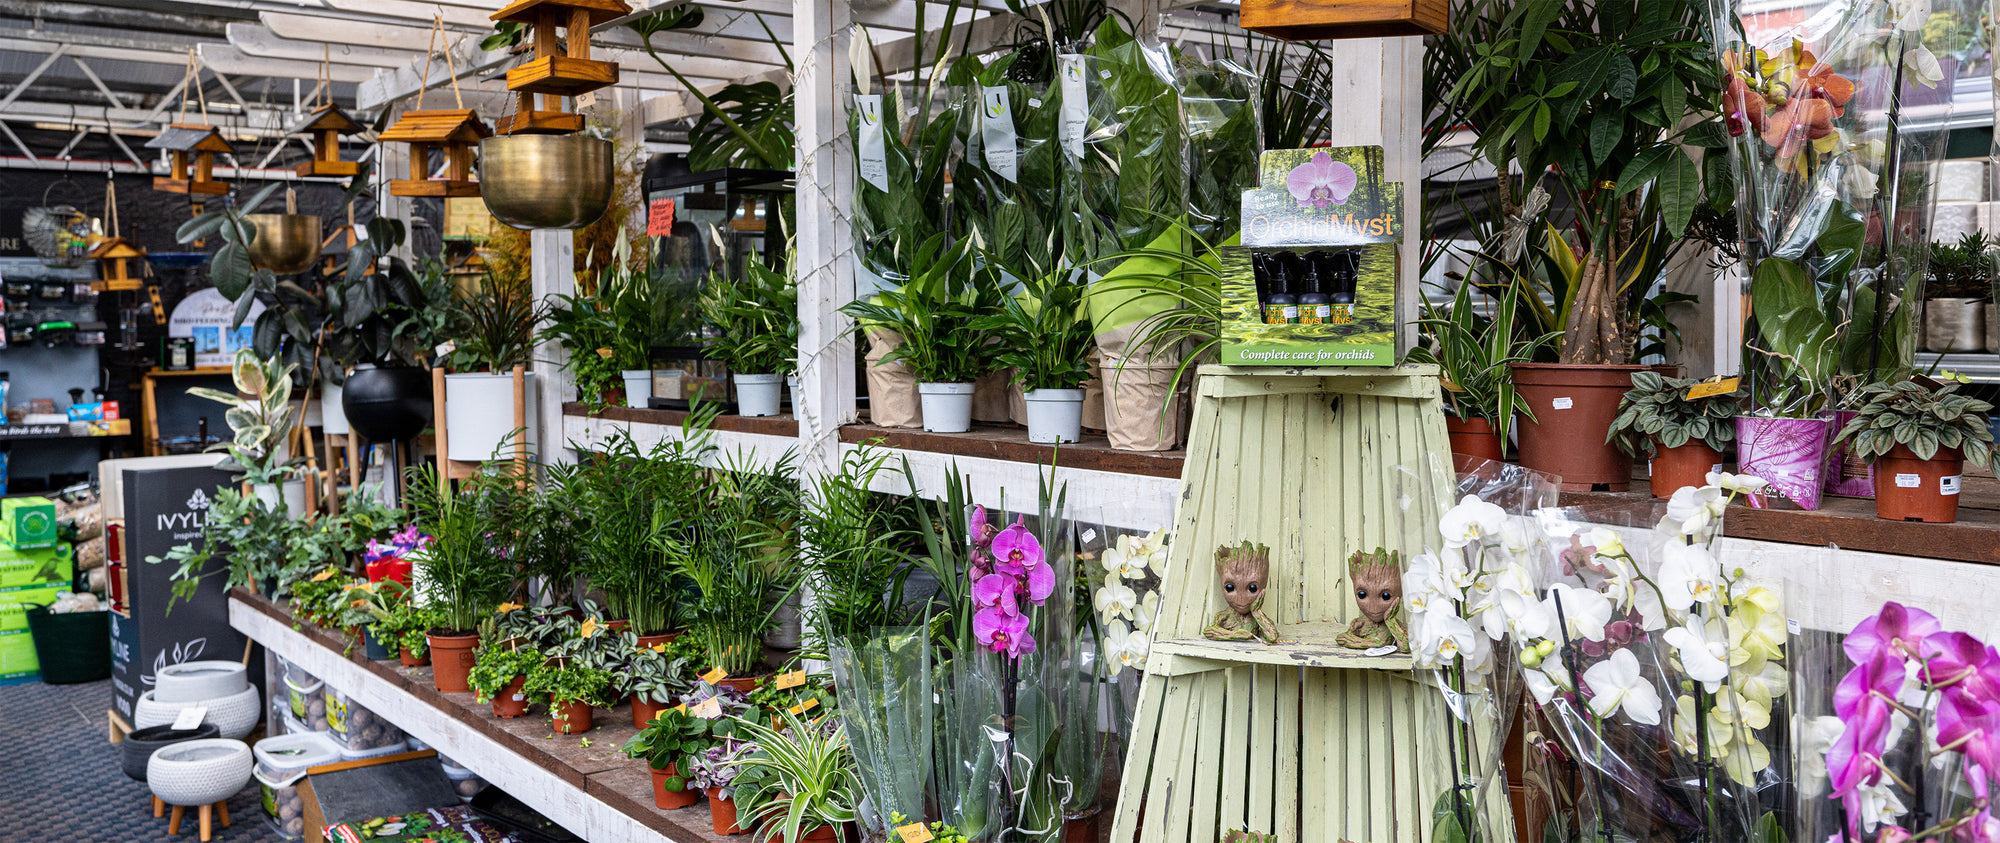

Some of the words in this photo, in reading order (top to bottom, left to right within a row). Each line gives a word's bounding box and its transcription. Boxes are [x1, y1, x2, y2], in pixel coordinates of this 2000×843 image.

[1254, 192, 1278, 202] Ready
[1266, 200, 1280, 208] use
[1249, 213, 1394, 239] OrchidMyst
[1333, 316, 1352, 325] Mys
[1240, 349, 1290, 363] Complete
[1292, 351, 1316, 360] care
[1313, 349, 1334, 363] for
[1335, 349, 1375, 360] orchids
